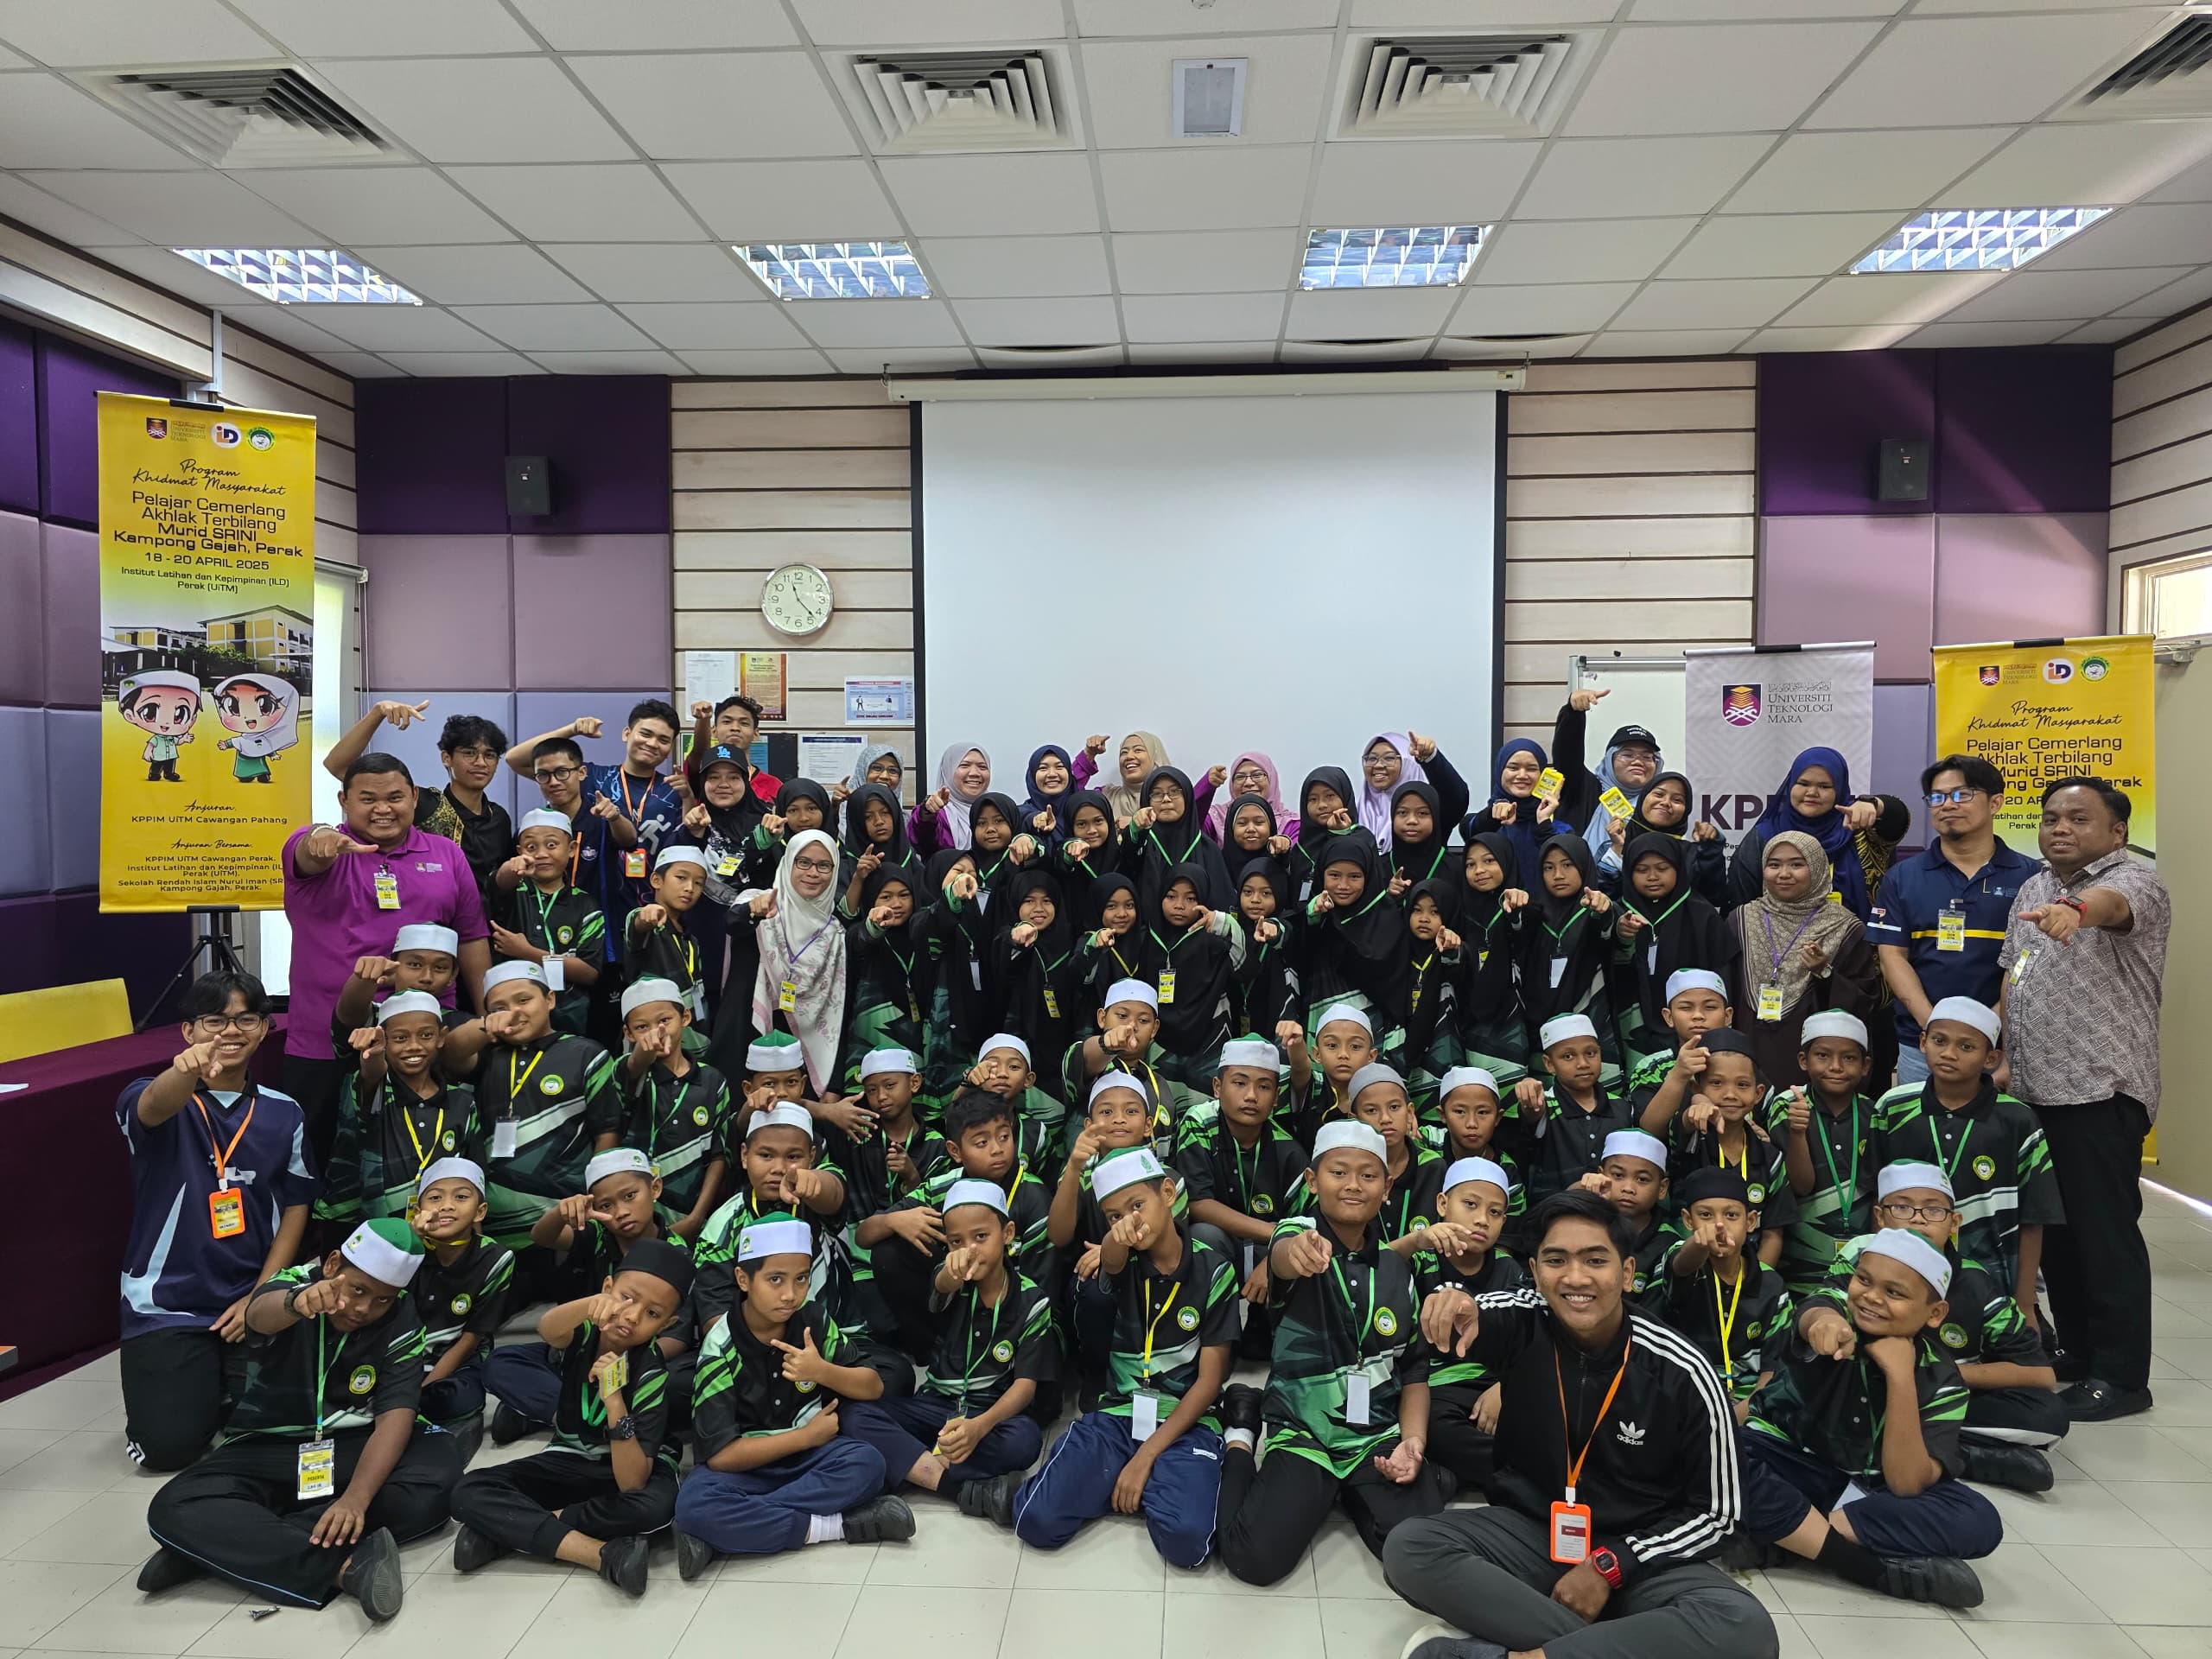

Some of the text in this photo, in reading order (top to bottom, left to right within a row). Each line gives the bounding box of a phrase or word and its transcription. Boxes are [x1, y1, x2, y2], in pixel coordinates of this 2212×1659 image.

[180, 459, 240, 477] Program
[132, 468, 286, 495] Khidmat Masyarakat
[132, 491, 285, 519] Pelajar Cemerlang
[142, 507, 276, 533] Akhlak Terbilang
[158, 523, 256, 542] Murid SRINI
[114, 531, 302, 557] Kampong Gajah, Perak
[145, 552, 162, 562] 18
[175, 555, 192, 564] 20
[195, 556, 232, 568] APRIL
[236, 560, 269, 570] 2025
[122, 567, 155, 576] Institut
[157, 569, 192, 580] Latihan
[195, 573, 212, 582] dan
[215, 575, 266, 586] Kepimpinan
[178, 582, 206, 591] Perak
[775, 583, 785, 592] 10
[816, 583, 823, 592] 2
[1768, 694, 1831, 702] UNIVERSITI
[1767, 704, 1833, 713] TEKNOLOGI
[2012, 700, 2073, 716] Program
[1768, 715, 1802, 723] MARA
[1967, 715, 2122, 732] Khidmat Masyarakat
[1967, 736, 2122, 752] Pelajar Cemerlang
[2033, 750, 2113, 766] Terbilang
[2044, 765, 2091, 777] SRINI
[2005, 796, 2023, 805] 20
[171, 839, 211, 849] Anjuran
